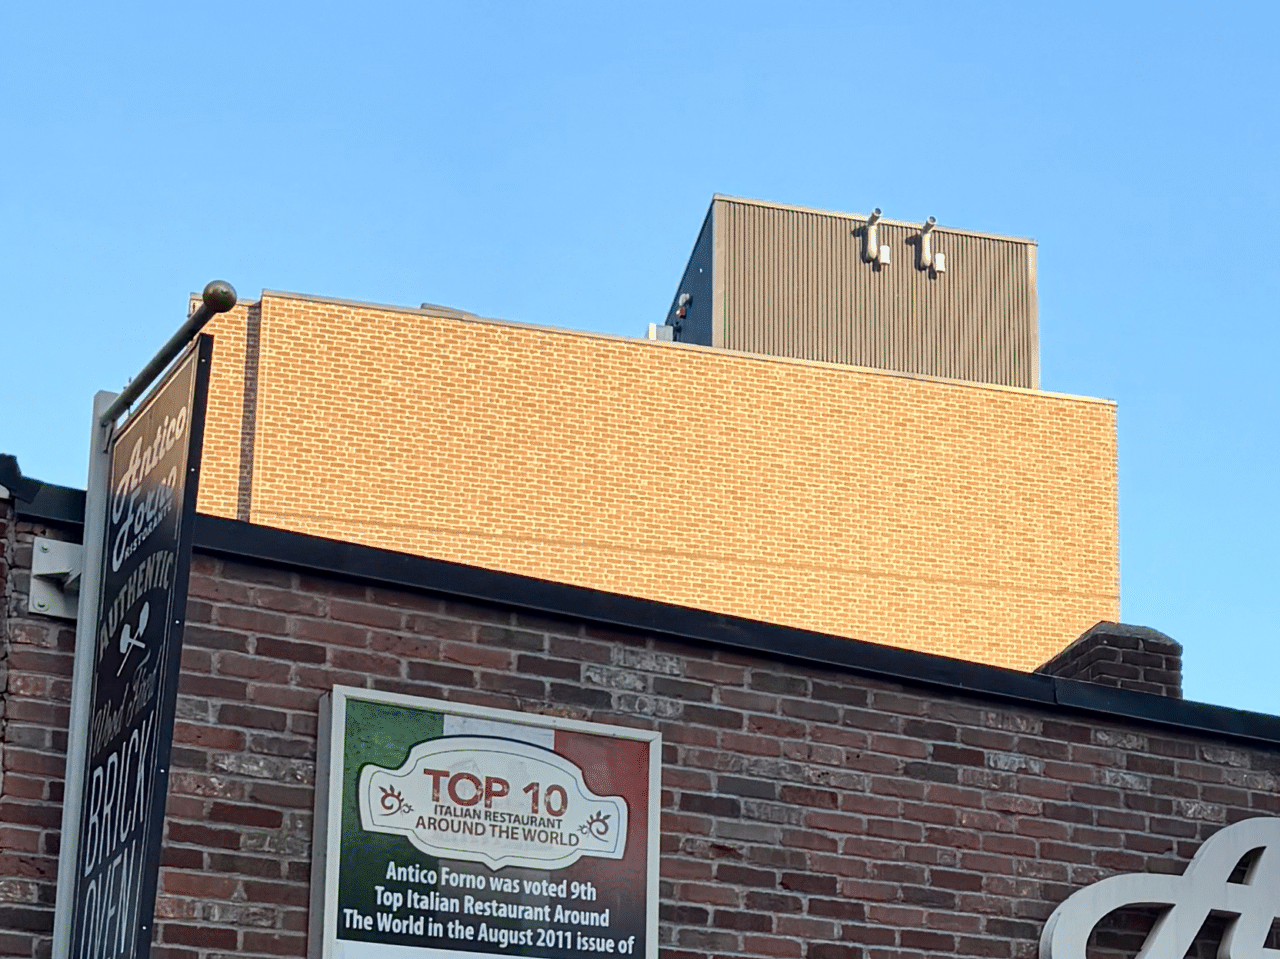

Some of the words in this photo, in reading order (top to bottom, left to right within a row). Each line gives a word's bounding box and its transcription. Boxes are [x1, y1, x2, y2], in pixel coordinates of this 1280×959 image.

[112, 406, 186, 524] Antico
[112, 466, 177, 572] Forno
[124, 499, 172, 560] RISTORANTE
[100, 550, 174, 664] AUTHENTIC
[93, 682, 130, 758] Wood
[84, 709, 154, 877] BRICK
[424, 769, 510, 809] TOP
[523, 782, 568, 817] 10
[434, 804, 481, 820] ITALIAN
[484, 811, 563, 829] RESTAURANT
[415, 816, 486, 837] AROUND
[490, 825, 520, 841] THE
[522, 828, 579, 847] WORLD
[375, 885, 403, 908] Top
[407, 889, 460, 914] Italian
[464, 895, 550, 922] Restaurant
[554, 905, 610, 928] Around
[386, 861, 437, 885] Antico
[441, 869, 486, 890] Forno
[490, 877, 520, 893] was
[523, 880, 567, 899] voted
[570, 882, 597, 902] 9th
[343, 908, 373, 930] The
[376, 913, 424, 937] World
[428, 918, 444, 938] in
[447, 920, 474, 941] the
[478, 922, 533, 948] August
[536, 929, 572, 949] 2011
[576, 932, 614, 953] issue
[617, 935, 635, 954] of
